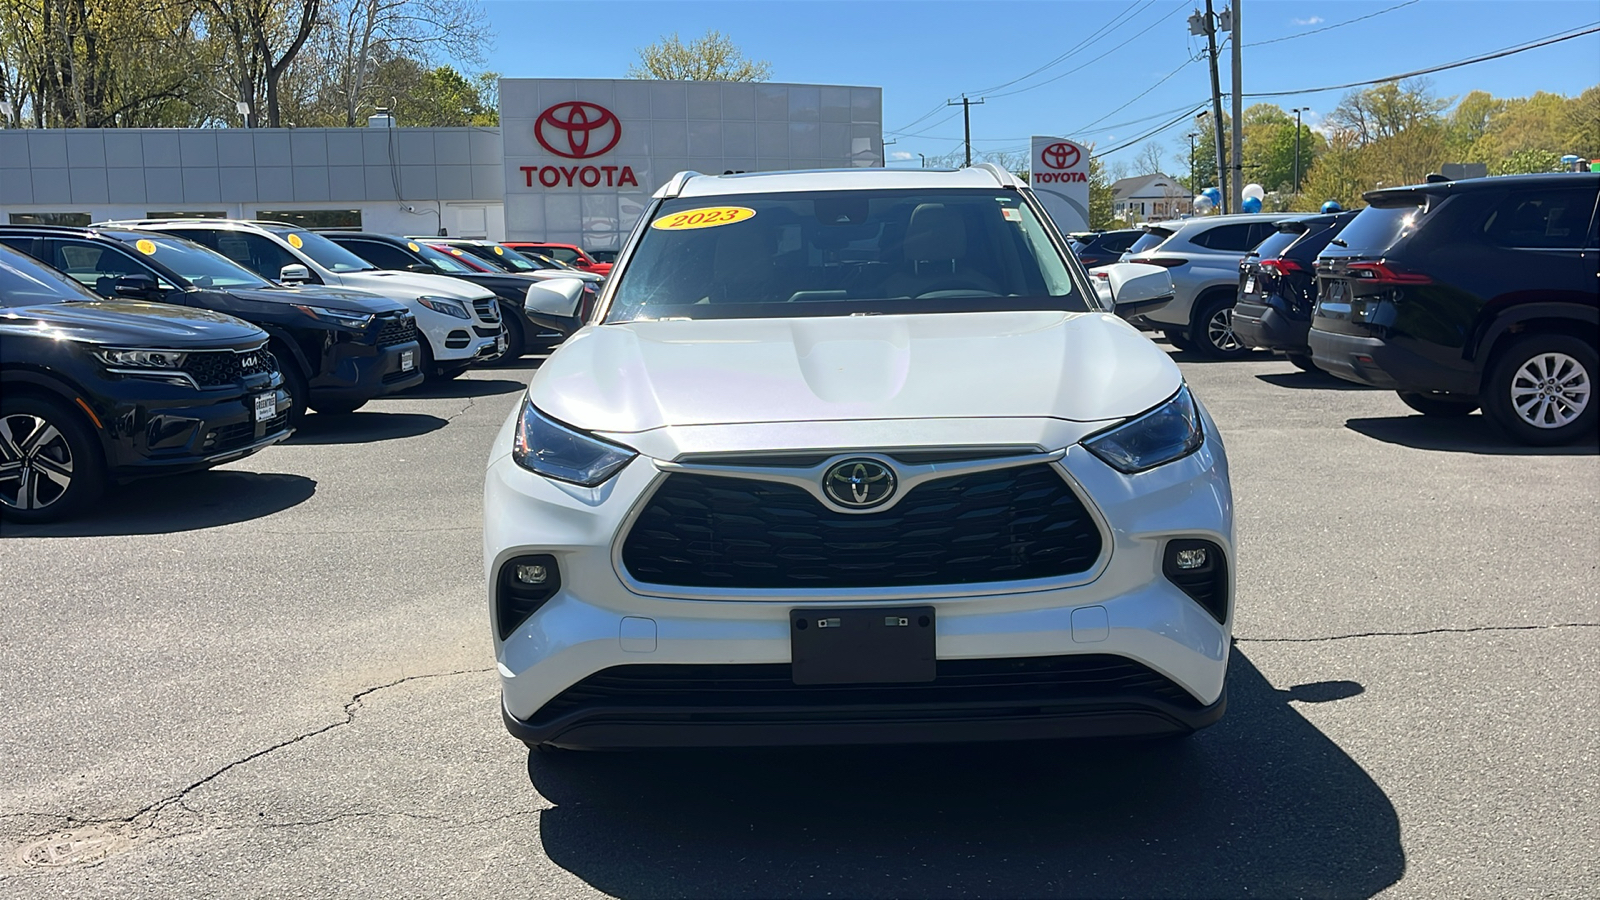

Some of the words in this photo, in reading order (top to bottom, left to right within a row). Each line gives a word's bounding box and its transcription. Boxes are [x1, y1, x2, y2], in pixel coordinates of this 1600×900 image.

[520, 165, 638, 187] TOYOTA
[1034, 172, 1087, 183] TOYOTA
[669, 209, 739, 228] 2023
